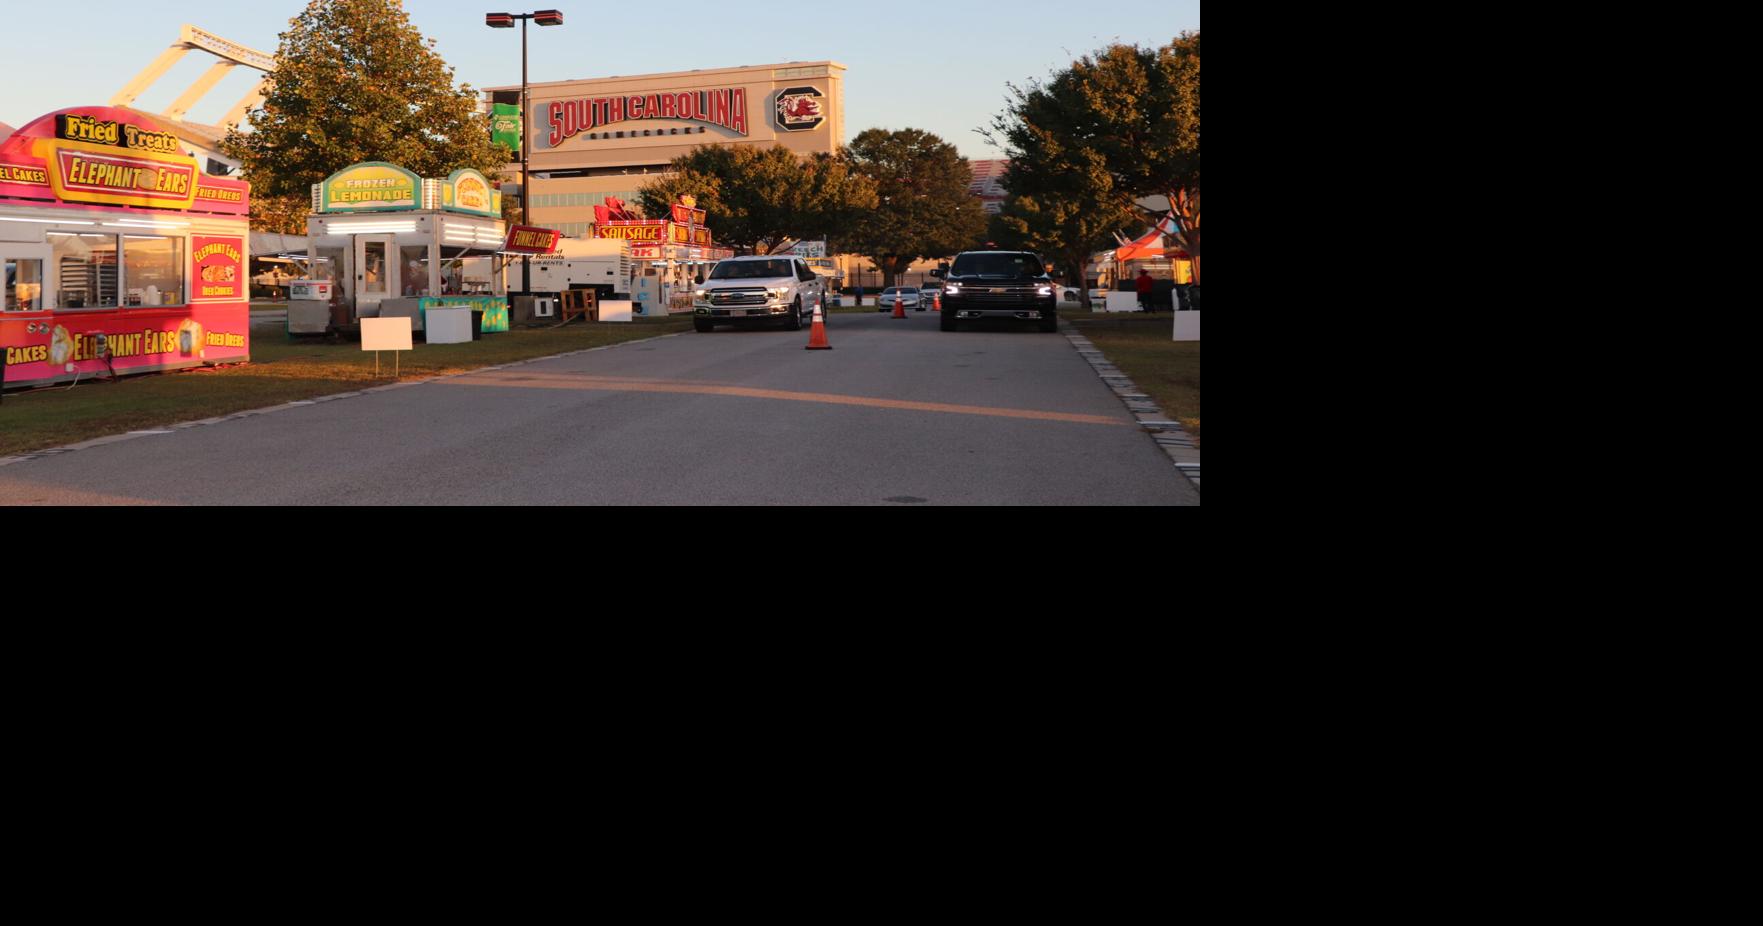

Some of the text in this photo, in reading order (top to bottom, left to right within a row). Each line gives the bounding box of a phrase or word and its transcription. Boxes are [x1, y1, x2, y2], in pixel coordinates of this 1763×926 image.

[548, 87, 747, 147] SOUTH CAROLINA
[65, 115, 178, 151] Fried Treats
[13, 168, 45, 182] CAKES
[69, 157, 188, 193] ELEPHANT EARS
[347, 178, 396, 188] FROZEN
[195, 187, 217, 199] FRIED
[330, 189, 413, 202] LEMONADE
[512, 230, 555, 248] FUNNEL CAKES
[601, 226, 657, 239] SAUSAGE
[193, 243, 241, 264] ELEPHANT EARS
[144, 328, 176, 354] EARS
[206, 331, 225, 346] FRIED
[6, 345, 48, 365] CAKES
